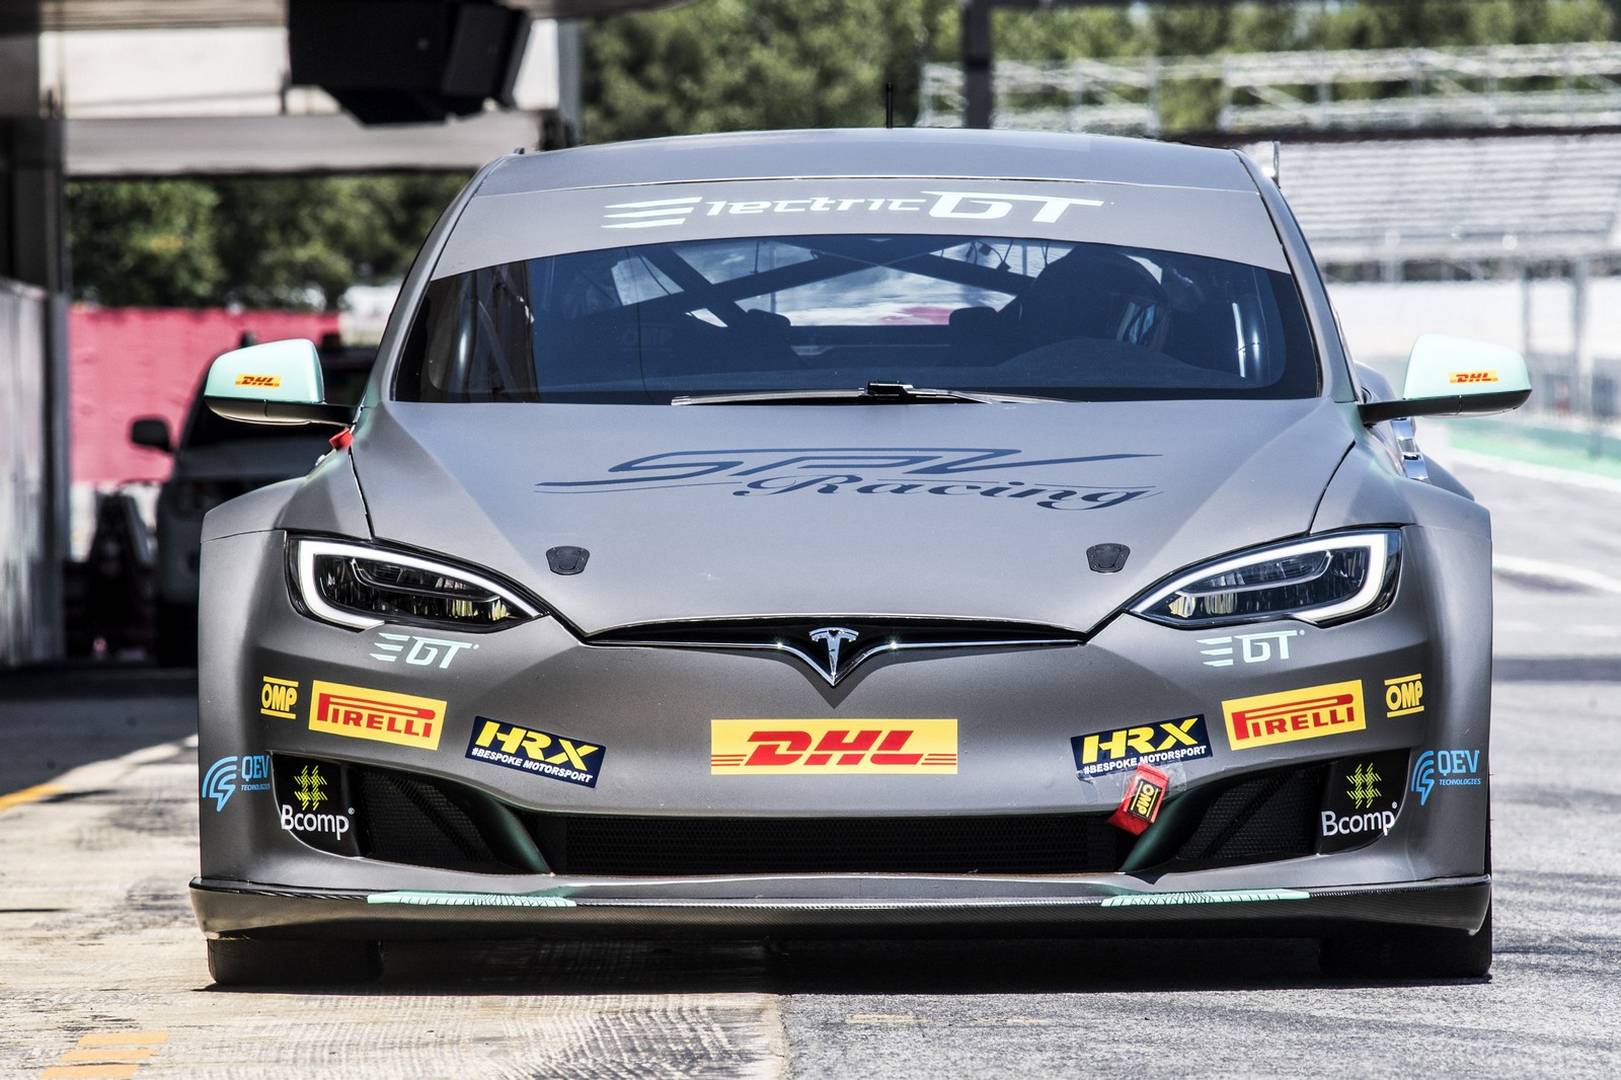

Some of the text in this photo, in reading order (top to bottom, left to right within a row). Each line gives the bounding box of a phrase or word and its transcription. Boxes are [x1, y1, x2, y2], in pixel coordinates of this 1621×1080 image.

[241, 376, 274, 386] DHL
[1455, 372, 1492, 383] DHL
[733, 474, 1163, 511] Racing
[261, 682, 298, 713] OMP
[1385, 679, 1424, 712] OMP
[316, 692, 437, 738] PIRELLI
[1231, 693, 1355, 741] PIRELLI
[475, 720, 599, 772] HRX
[744, 730, 924, 766] DHL
[1082, 717, 1199, 764] HRX
[241, 755, 270, 782] QEV
[471, 747, 593, 783] #BESPOKE MOTORSPORT
[1083, 745, 1206, 775] #BESPOKE MOTORSPORT
[1437, 749, 1480, 776] QEV
[1136, 783, 1155, 815] OMP
